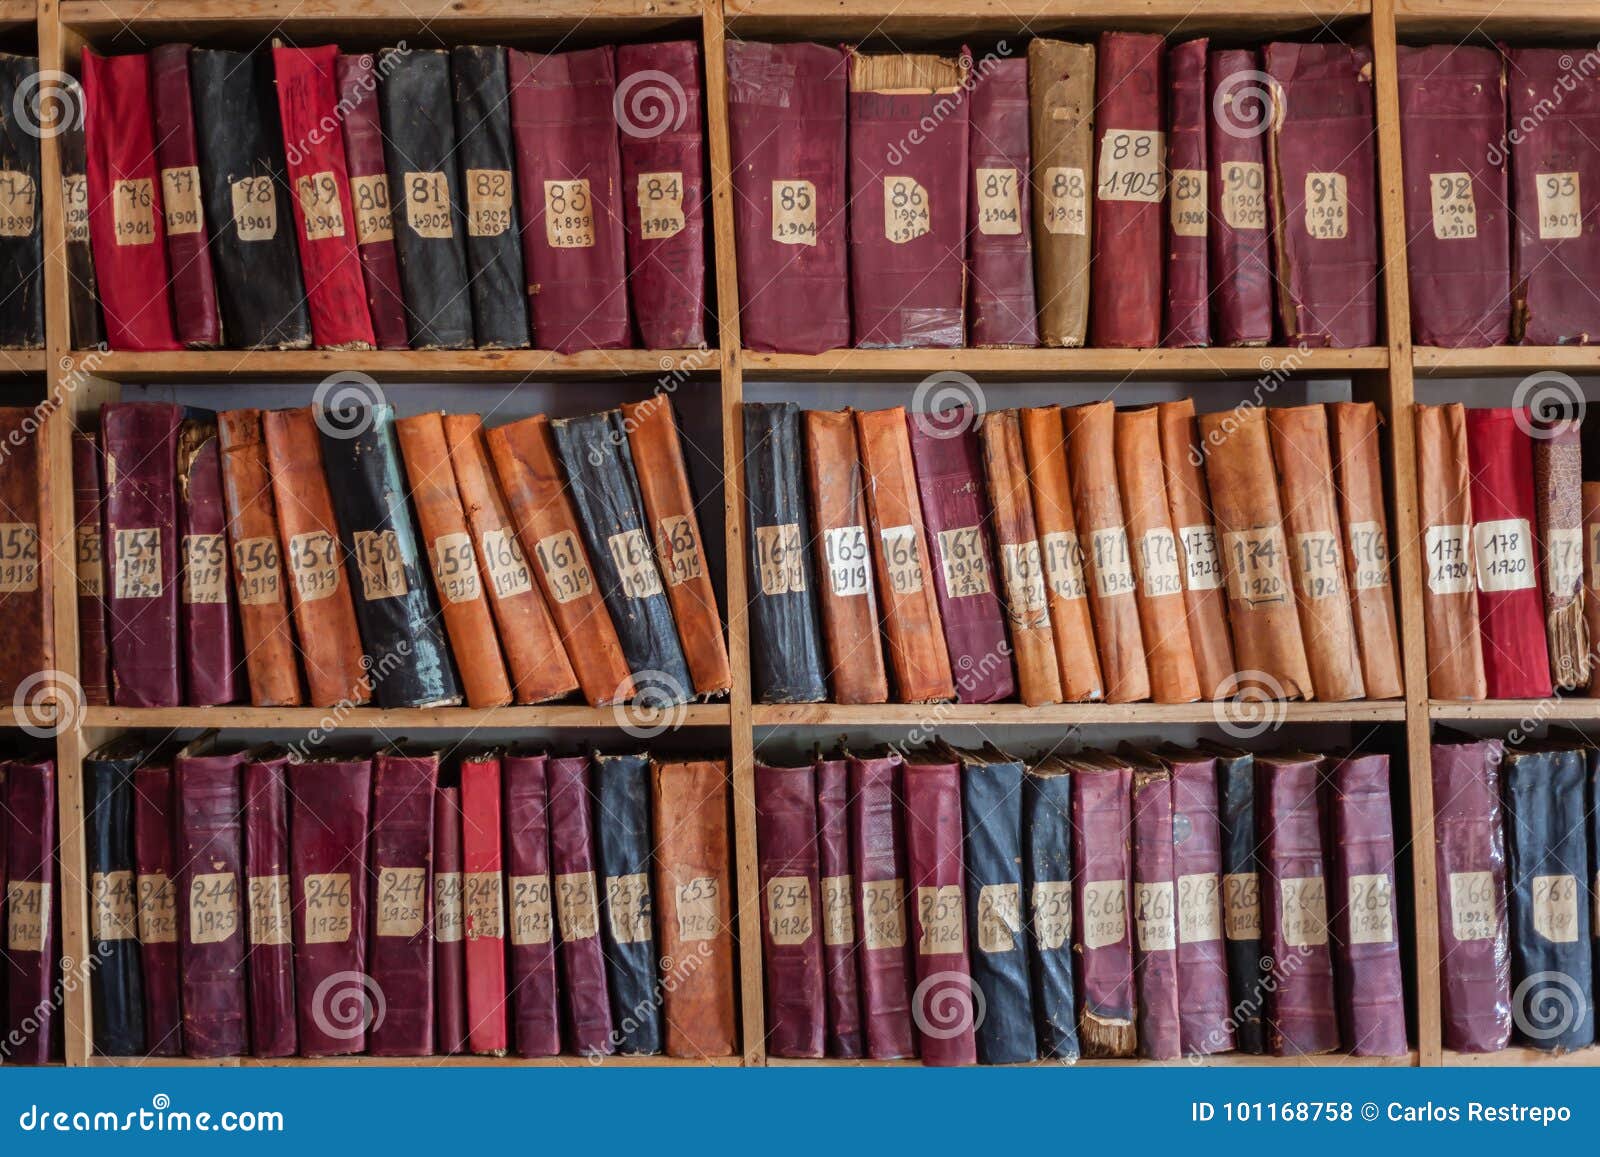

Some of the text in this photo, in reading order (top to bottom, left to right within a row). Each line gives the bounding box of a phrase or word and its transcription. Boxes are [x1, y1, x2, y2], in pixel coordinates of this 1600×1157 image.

[1114, 135, 1151, 159] 88
[64, 180, 88, 203] 75
[167, 171, 193, 193] 77
[413, 178, 439, 203] 81
[477, 174, 505, 197] 82
[648, 179, 679, 200] 84
[985, 175, 1012, 197] 87
[1052, 174, 1083, 198] 88
[1176, 176, 1201, 199] 89
[1229, 167, 1262, 191] 90
[1312, 177, 1338, 202] 91
[1440, 177, 1470, 199] 92
[1547, 177, 1576, 198] 93
[120, 184, 150, 208] 76
[240, 181, 271, 203] 78
[358, 181, 387, 210] 80
[551, 185, 586, 213] 83
[781, 187, 810, 211] 85
[892, 182, 921, 207] 86
[117, 532, 160, 558] 154
[292, 536, 334, 570] 157
[359, 533, 397, 565] 158
[537, 537, 577, 573] 161
[760, 533, 801, 565] 164
[827, 532, 866, 563] 165
[941, 531, 978, 559] 167
[1095, 532, 1127, 568] 171
[1144, 534, 1175, 568] 172
[1185, 533, 1216, 554] 173
[1353, 533, 1385, 562] 176
[1432, 539, 1463, 560] 177
[1484, 534, 1518, 554] 178
[236, 542, 278, 573] 156
[438, 542, 472, 577] 159
[1235, 539, 1275, 574] 174
[193, 881, 236, 908] 244
[309, 879, 349, 909] 246
[384, 873, 425, 903] 247
[468, 878, 499, 905] 249
[516, 883, 549, 908] 250
[773, 885, 808, 909] 254
[827, 888, 850, 912] 25
[920, 895, 961, 923] 257
[1037, 891, 1070, 920] 259
[1088, 890, 1123, 918] 260
